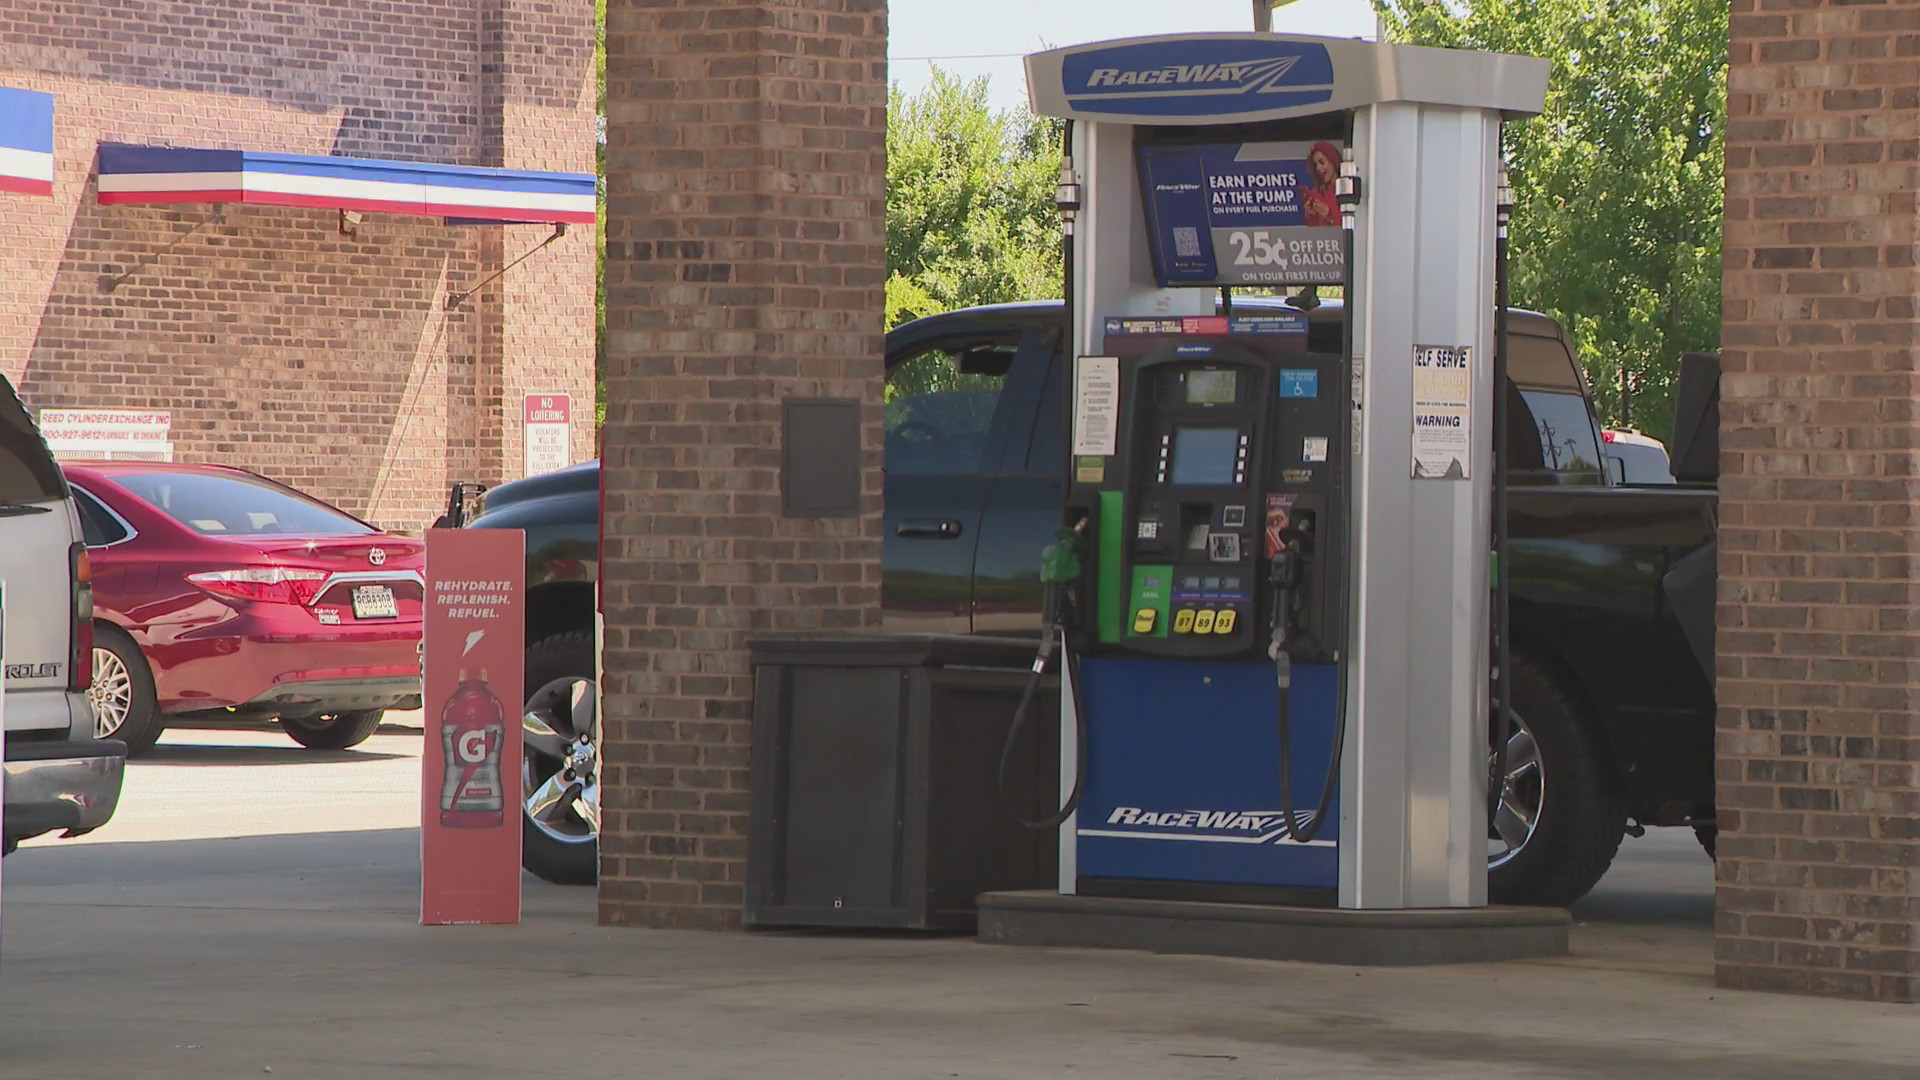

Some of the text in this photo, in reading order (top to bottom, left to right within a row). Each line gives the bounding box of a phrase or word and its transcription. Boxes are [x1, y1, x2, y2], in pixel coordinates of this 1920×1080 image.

[1209, 173, 1297, 188] EARN POINTS
[1212, 190, 1294, 205] AT THE PUMP
[1213, 204, 1298, 214] ON EVERY FUEL PURCHASE!
[1229, 231, 1288, 270] 25¢
[1289, 239, 1340, 252] OFF PER
[1292, 253, 1344, 265] GALLON
[1242, 272, 1257, 280] ON
[1259, 272, 1284, 280] YOUR
[1285, 271, 1308, 280] FIRST
[1436, 350, 1467, 368] SERVE
[541, 397, 553, 409] NO
[42, 413, 170, 425] REED CYLINDER EXCHANGE INC
[530, 410, 565, 421] LOITERING
[1416, 415, 1460, 427] WARNING
[535, 427, 561, 436] VIOLATORS
[434, 581, 513, 591] REHYDRATE.
[437, 594, 511, 605] REPLENISH.
[448, 608, 499, 618] REFUEL.
[1178, 617, 1230, 628] 87 89 93
[458, 729, 486, 763] G
